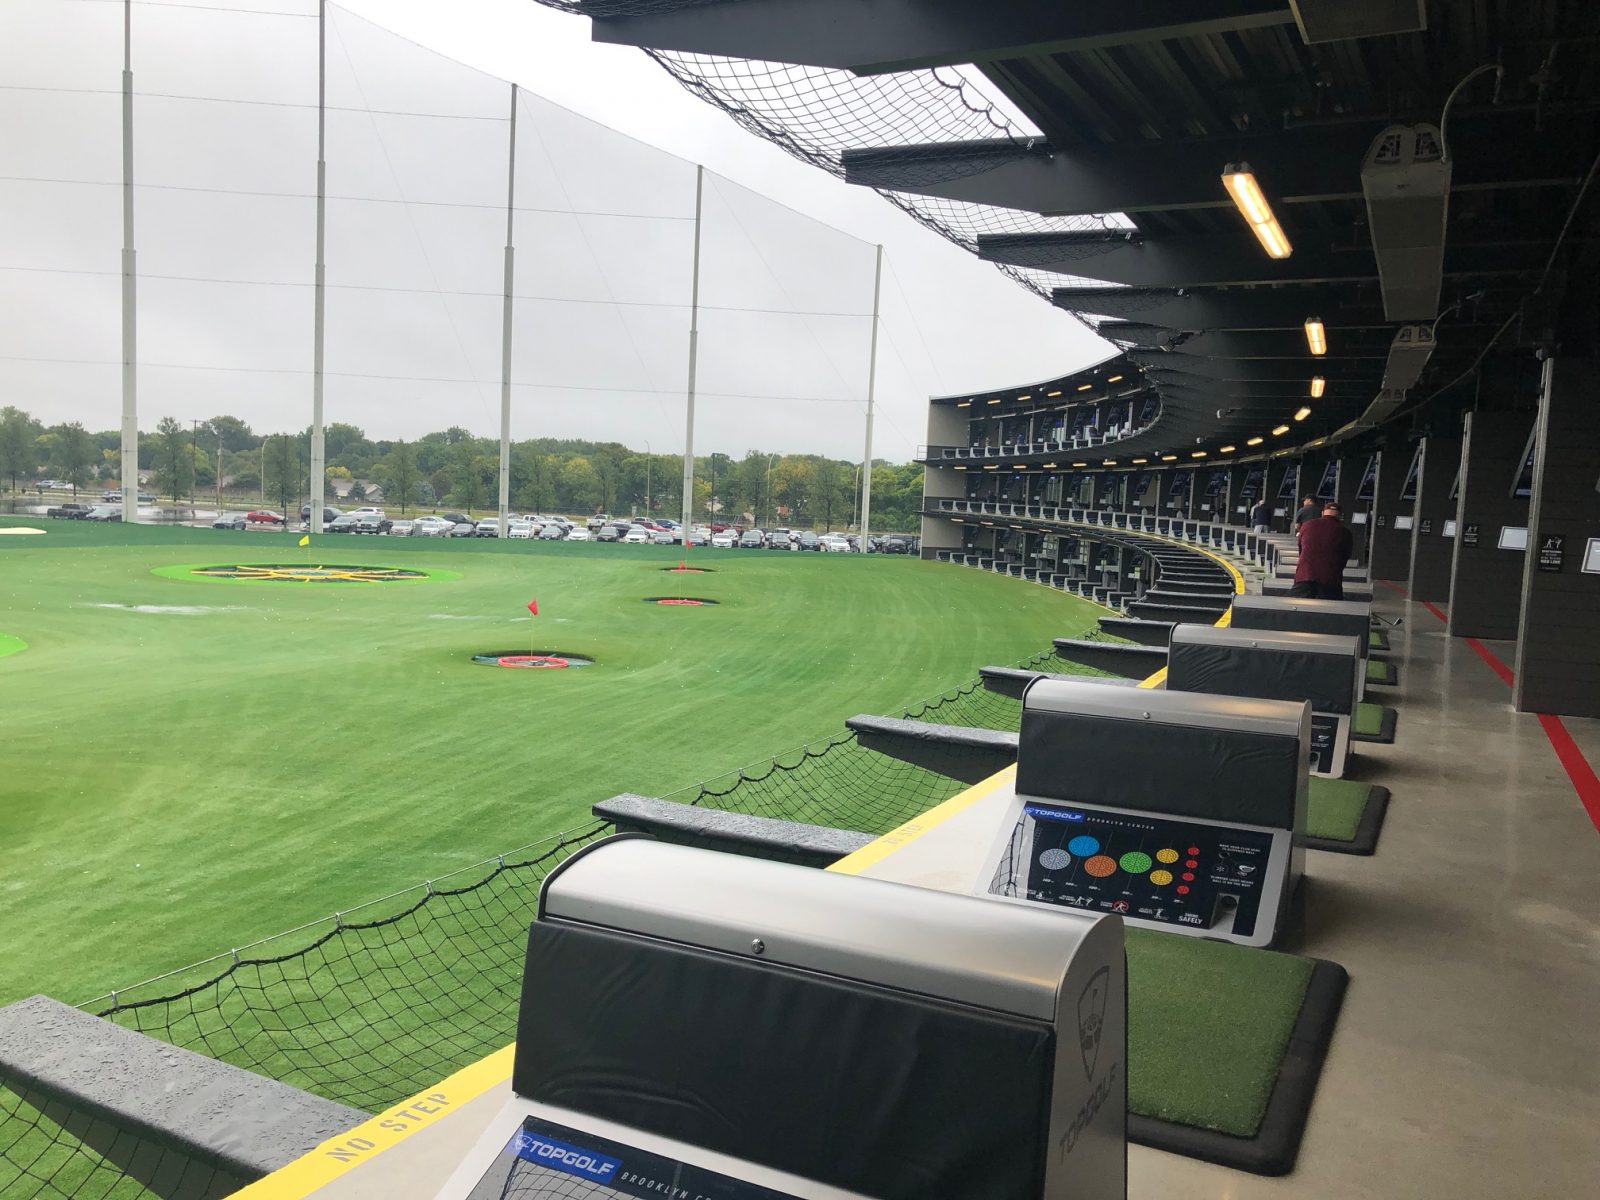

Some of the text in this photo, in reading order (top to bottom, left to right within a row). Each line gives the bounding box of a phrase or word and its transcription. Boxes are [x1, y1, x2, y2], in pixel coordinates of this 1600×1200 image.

[1034, 808, 1082, 822] TOPGOLF
[1178, 915, 1203, 925] SAFELY
[325, 1093, 450, 1163] NO STEP
[529, 1139, 615, 1176] TOPGOLF
[621, 1171, 689, 1199] BROOKLYN
